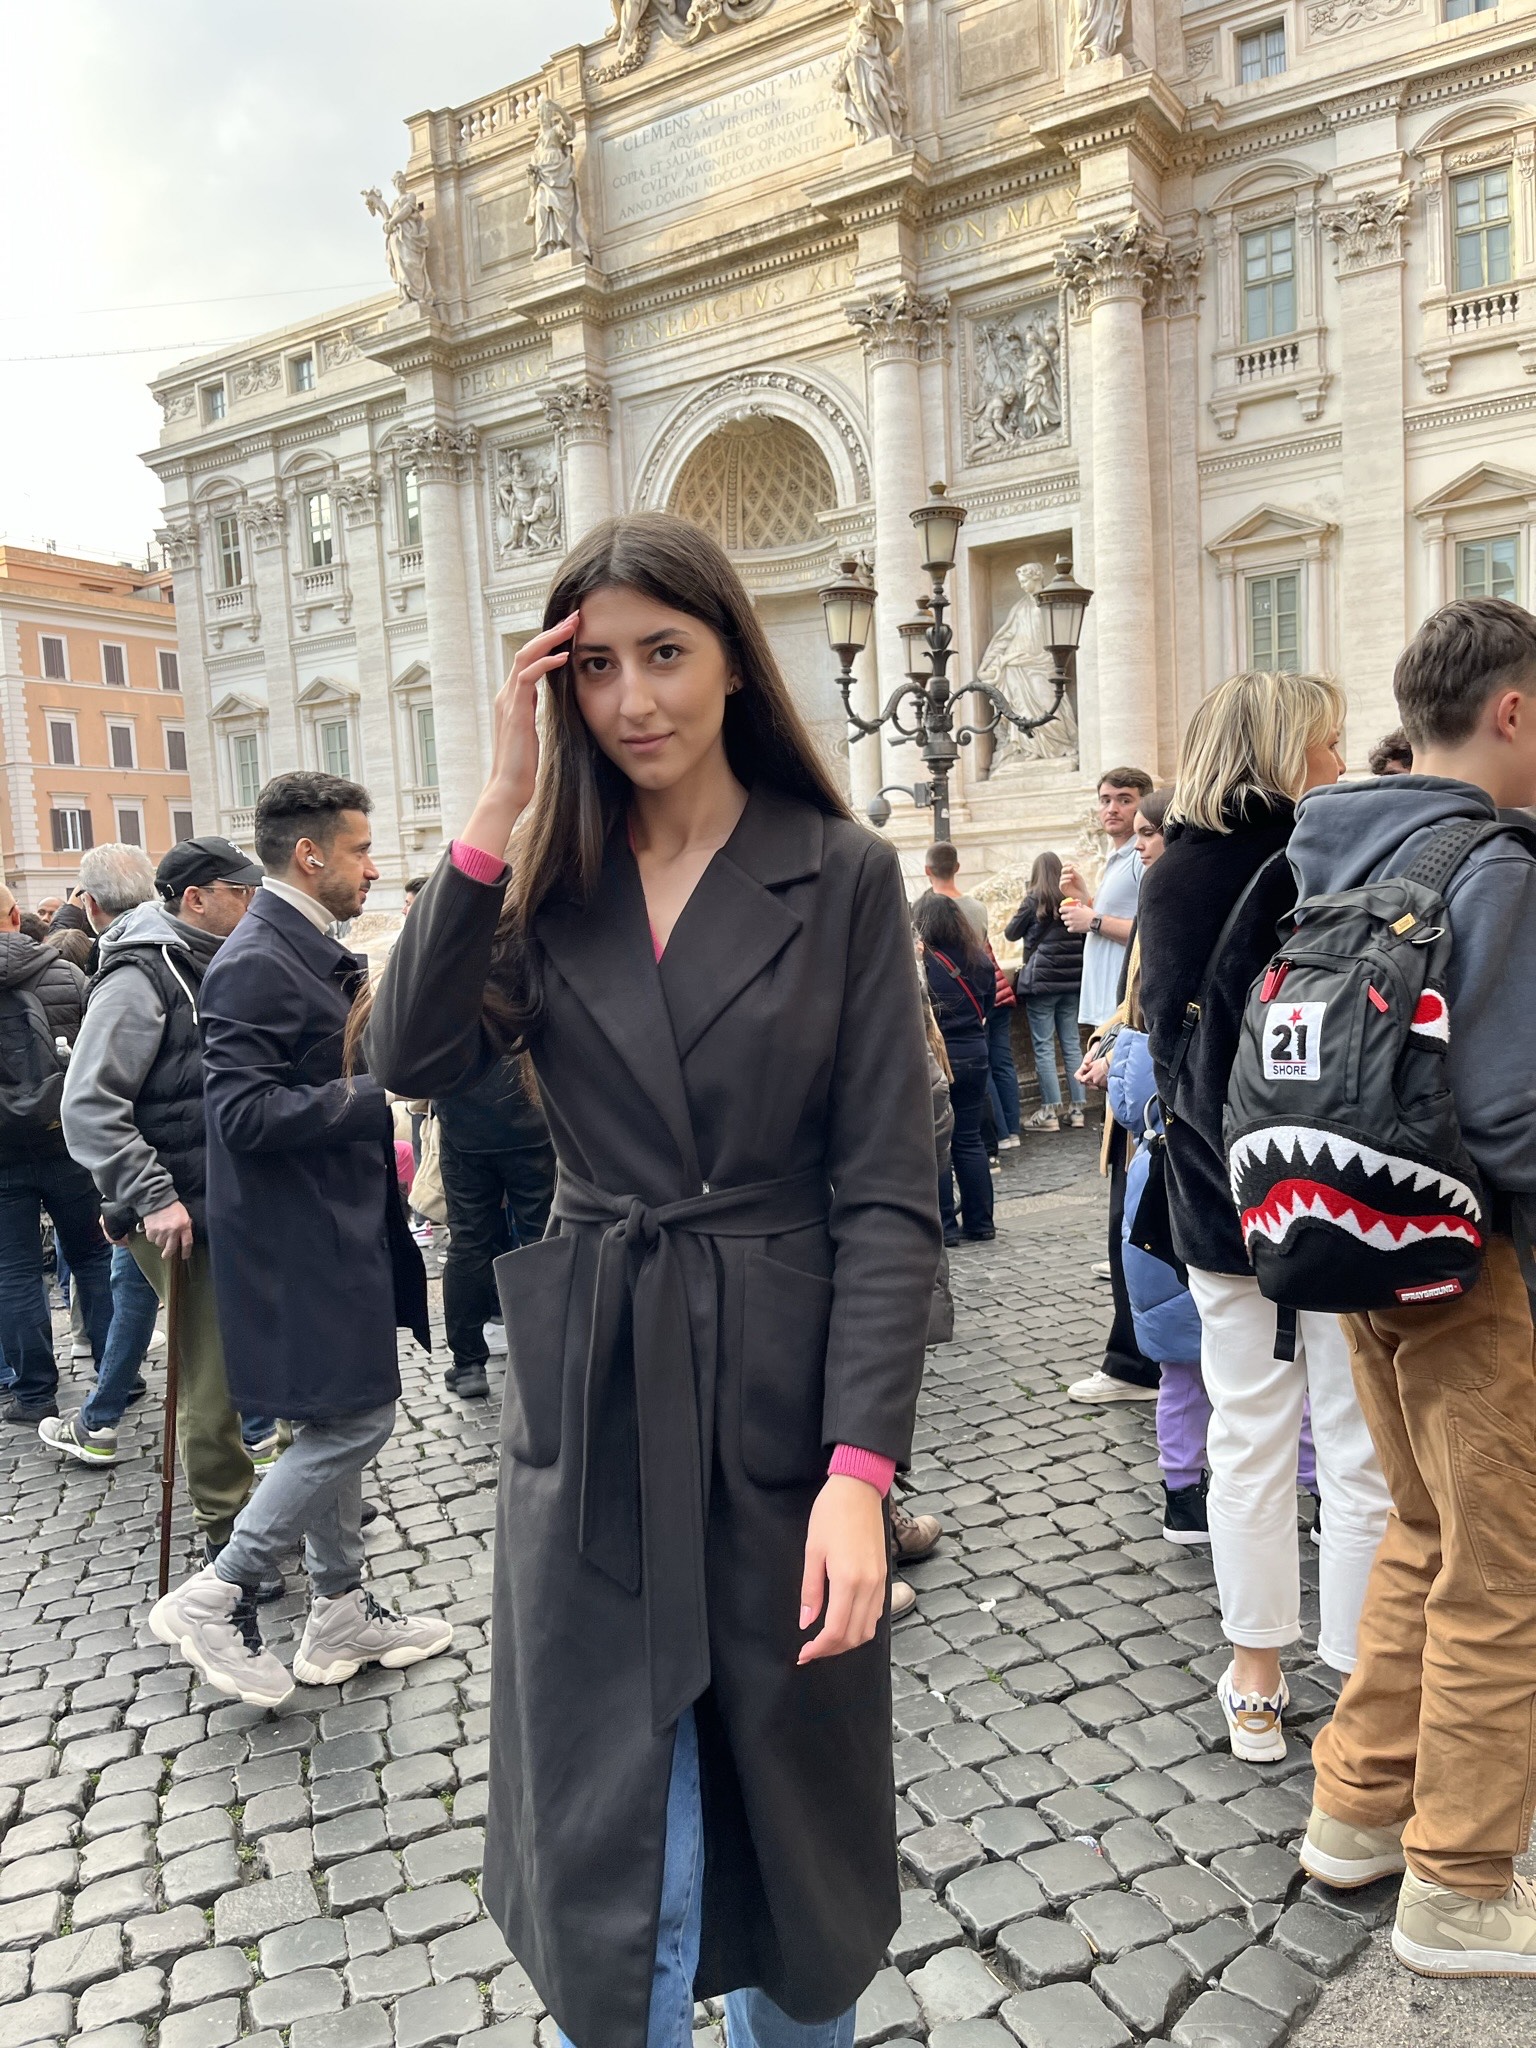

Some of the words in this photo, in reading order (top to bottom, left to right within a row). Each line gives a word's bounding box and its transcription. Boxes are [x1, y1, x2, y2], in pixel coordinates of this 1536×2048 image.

[612, 169, 645, 189] COPIA
[650, 161, 663, 176] ET
[747, 98, 832, 139] COMMENDAT
[622, 114, 690, 152] CLEMENS
[669, 126, 712, 152] AQVAM
[720, 98, 781, 131] VIRGINEM
[641, 172, 678, 195] CVLTV
[685, 145, 753, 180] MAGNIFICO
[759, 120, 816, 152] ORNAVIT
[619, 199, 652, 220] ANNO
[655, 182, 698, 207] DOMINI
[613, 279, 786, 351] BENEDICTVS
[1270, 1024, 1308, 1061] 21
[1273, 1065, 1307, 1076] SHORE
[1401, 1284, 1454, 1301] SPRAYGROUND
